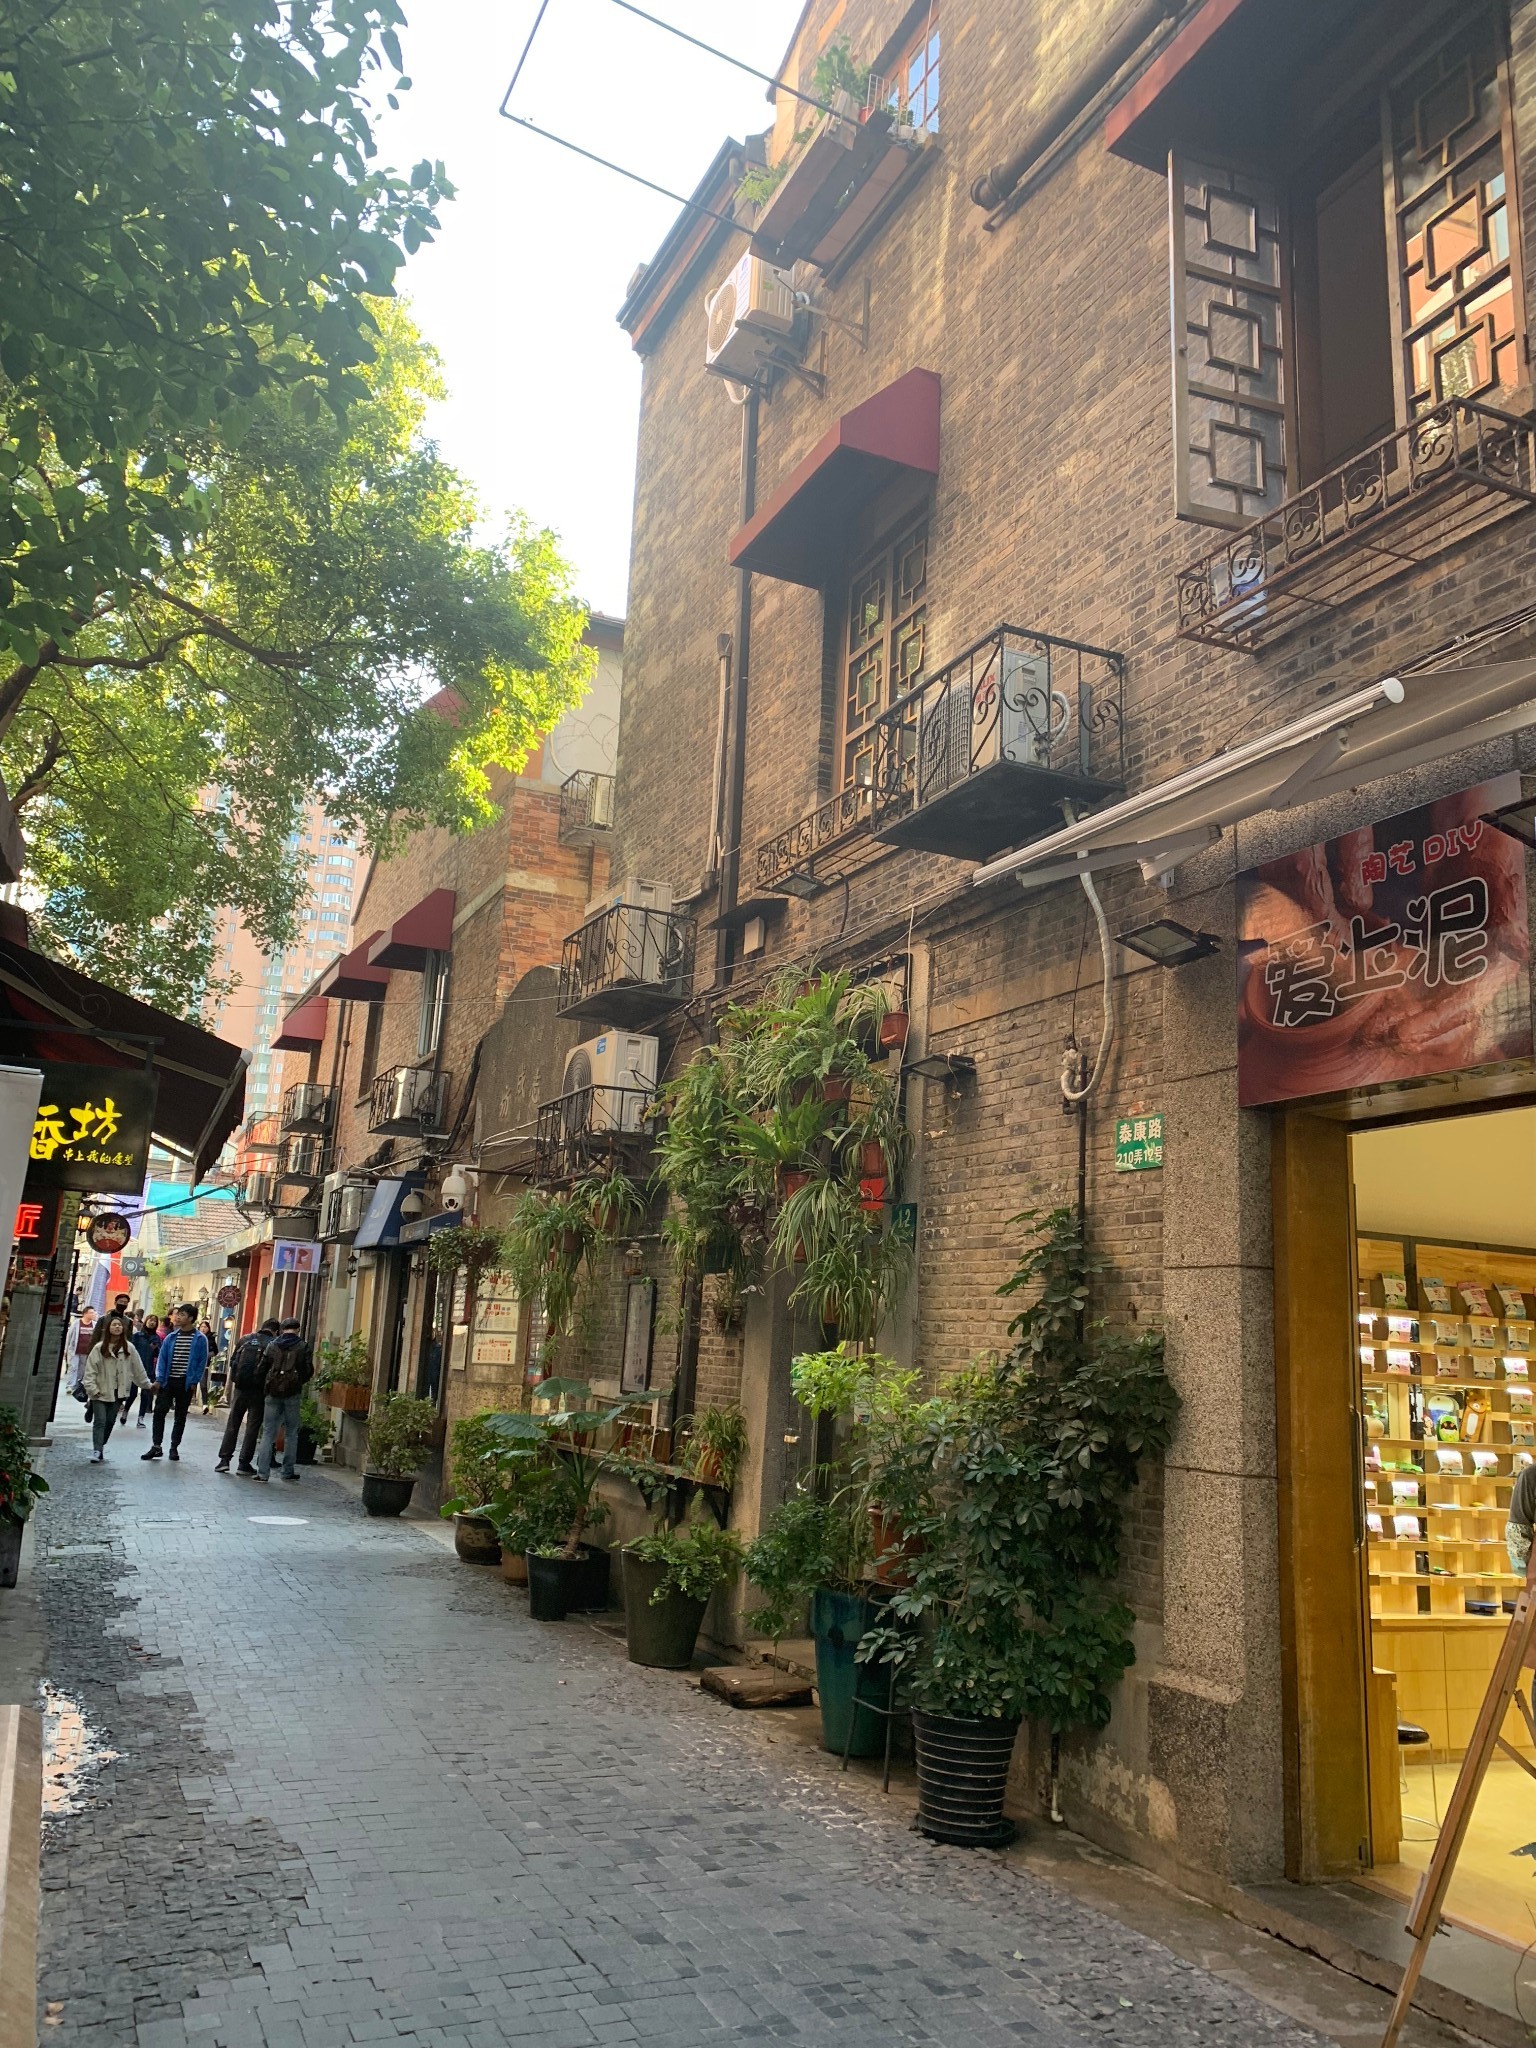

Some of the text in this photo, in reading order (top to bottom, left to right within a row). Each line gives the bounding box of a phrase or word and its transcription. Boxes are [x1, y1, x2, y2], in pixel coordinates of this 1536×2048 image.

[1361, 819, 1484, 886] 陶艺 DIY
[1265, 876, 1489, 1028] 爱上泥
[1119, 1118, 1162, 1144] 泰康路
[898, 1208, 911, 1228] 12
